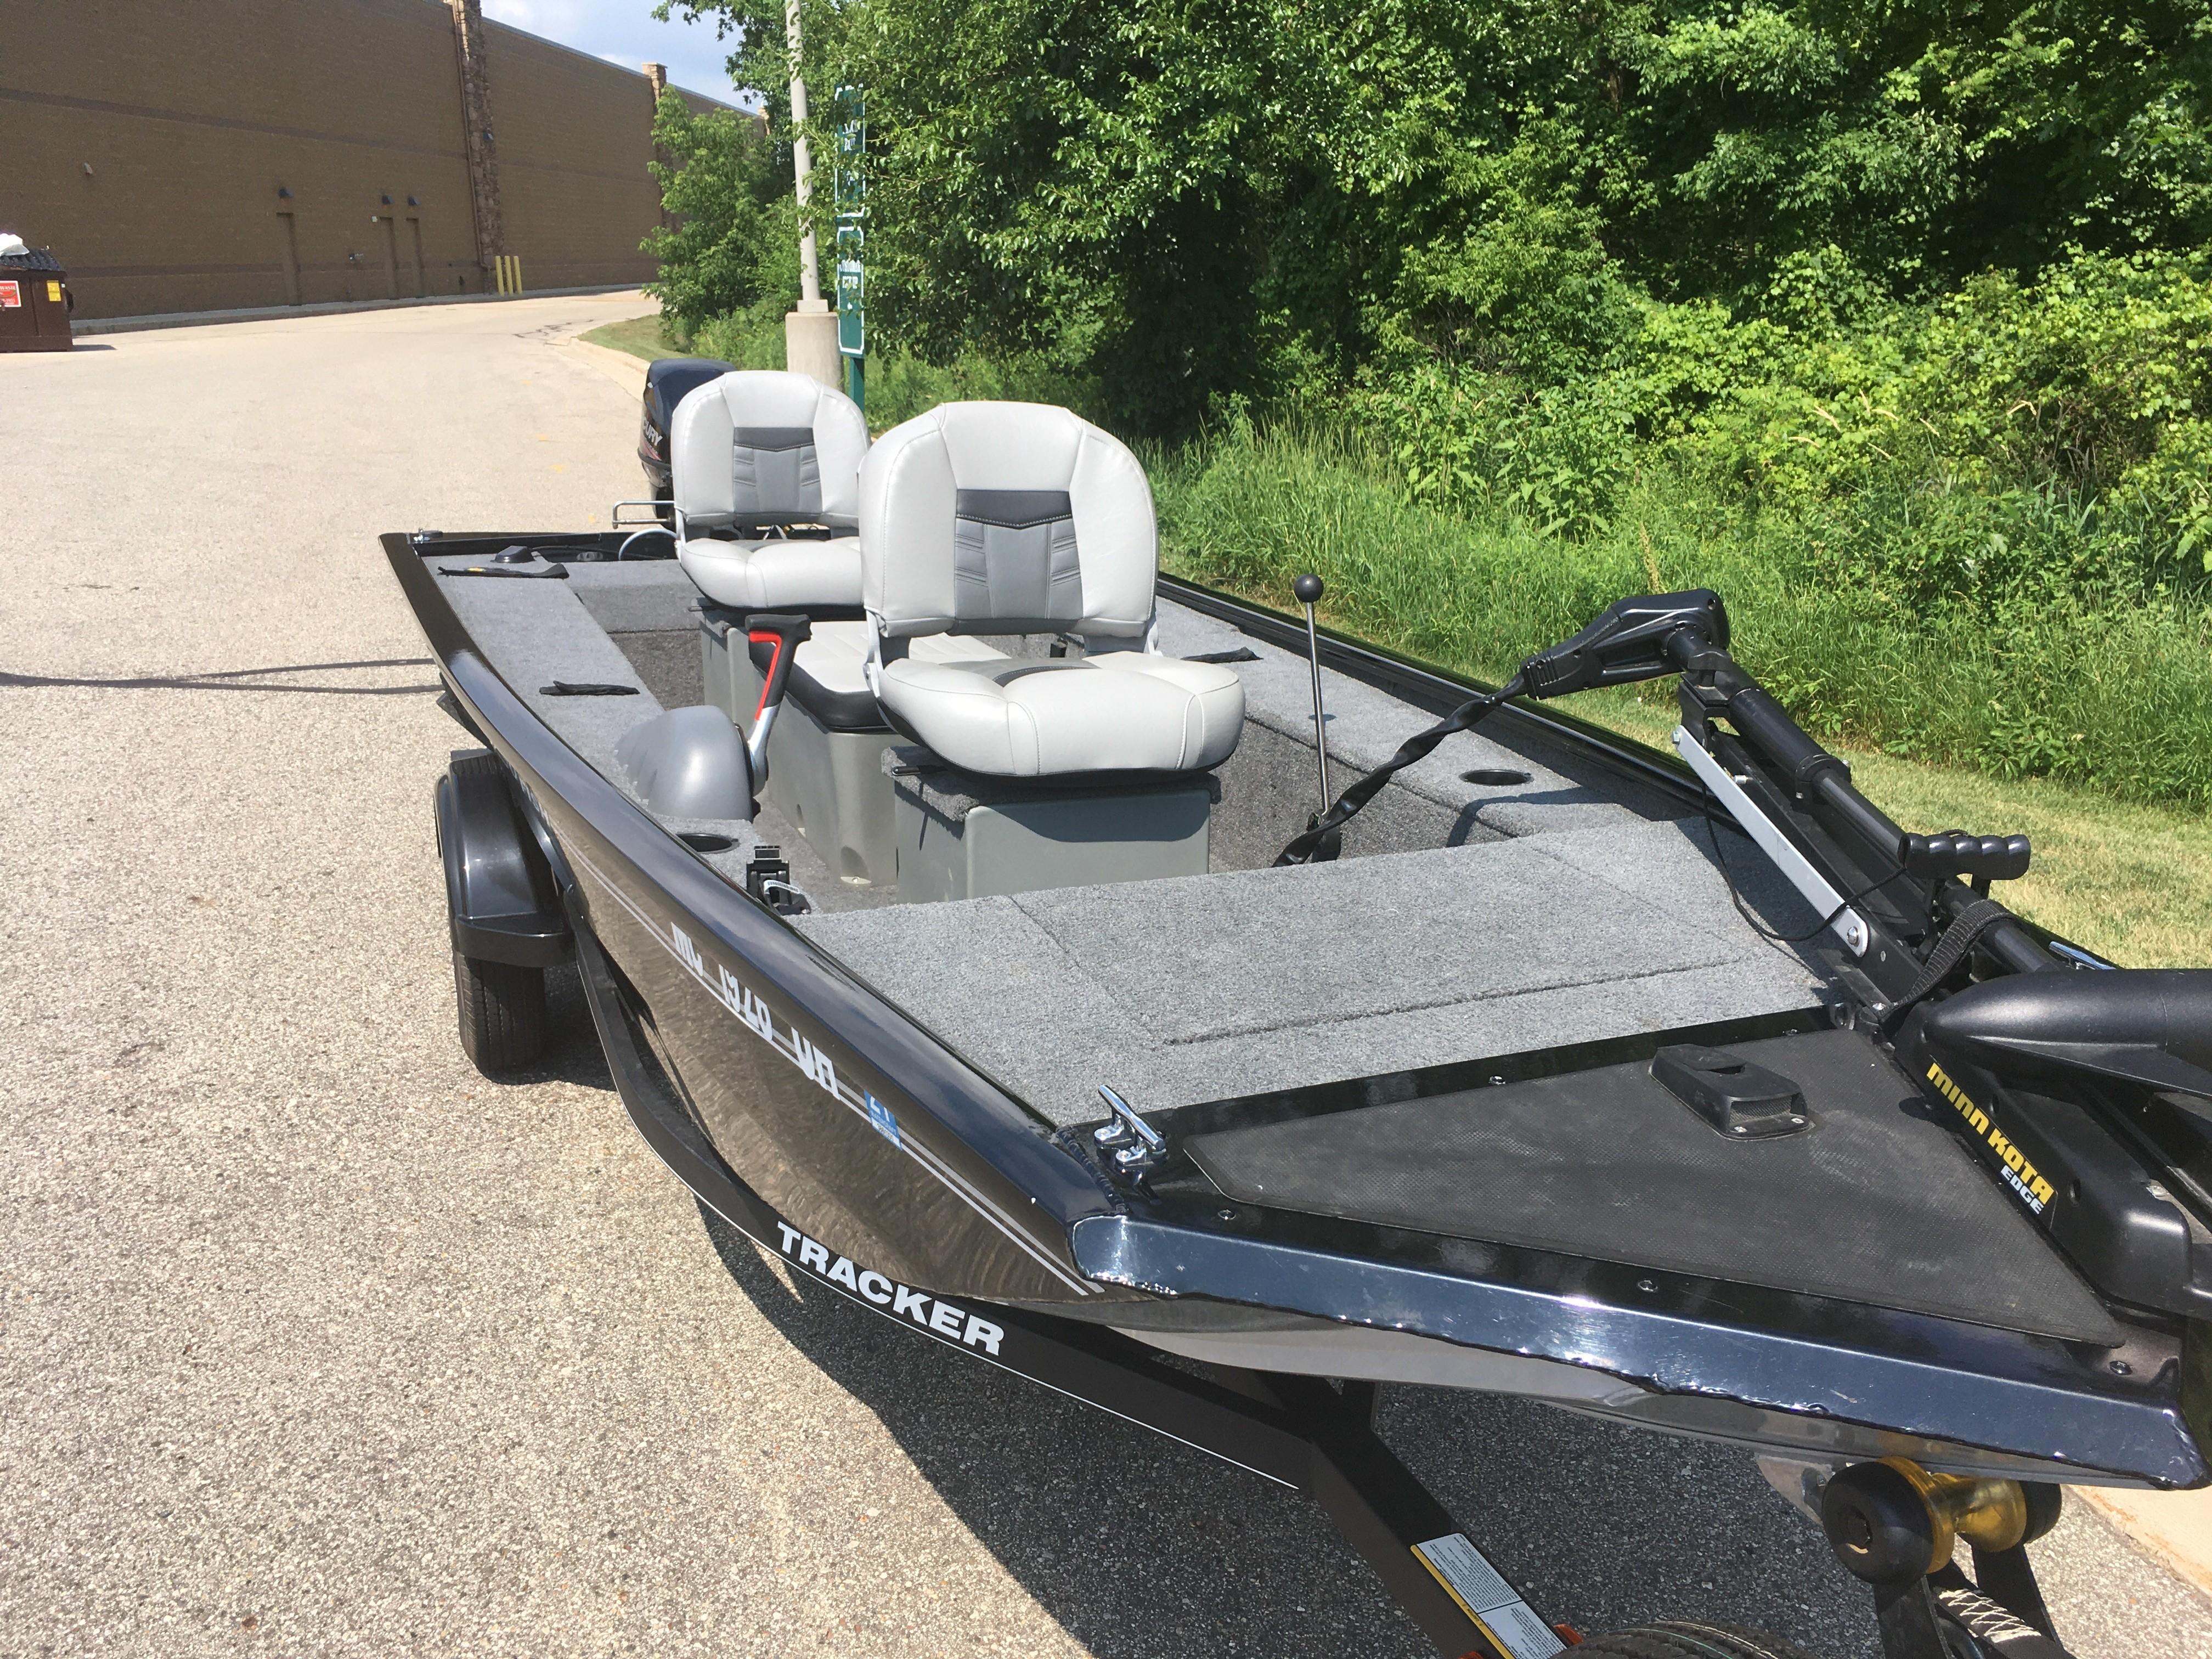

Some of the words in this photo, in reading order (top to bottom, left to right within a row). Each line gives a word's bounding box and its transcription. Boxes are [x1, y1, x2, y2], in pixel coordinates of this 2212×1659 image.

[1927, 1063, 1990, 1135] MINN
[1987, 1128, 2055, 1205] KOTA
[2000, 1165, 2044, 1215] EDGE
[776, 1221, 1005, 1356] TRACKER
